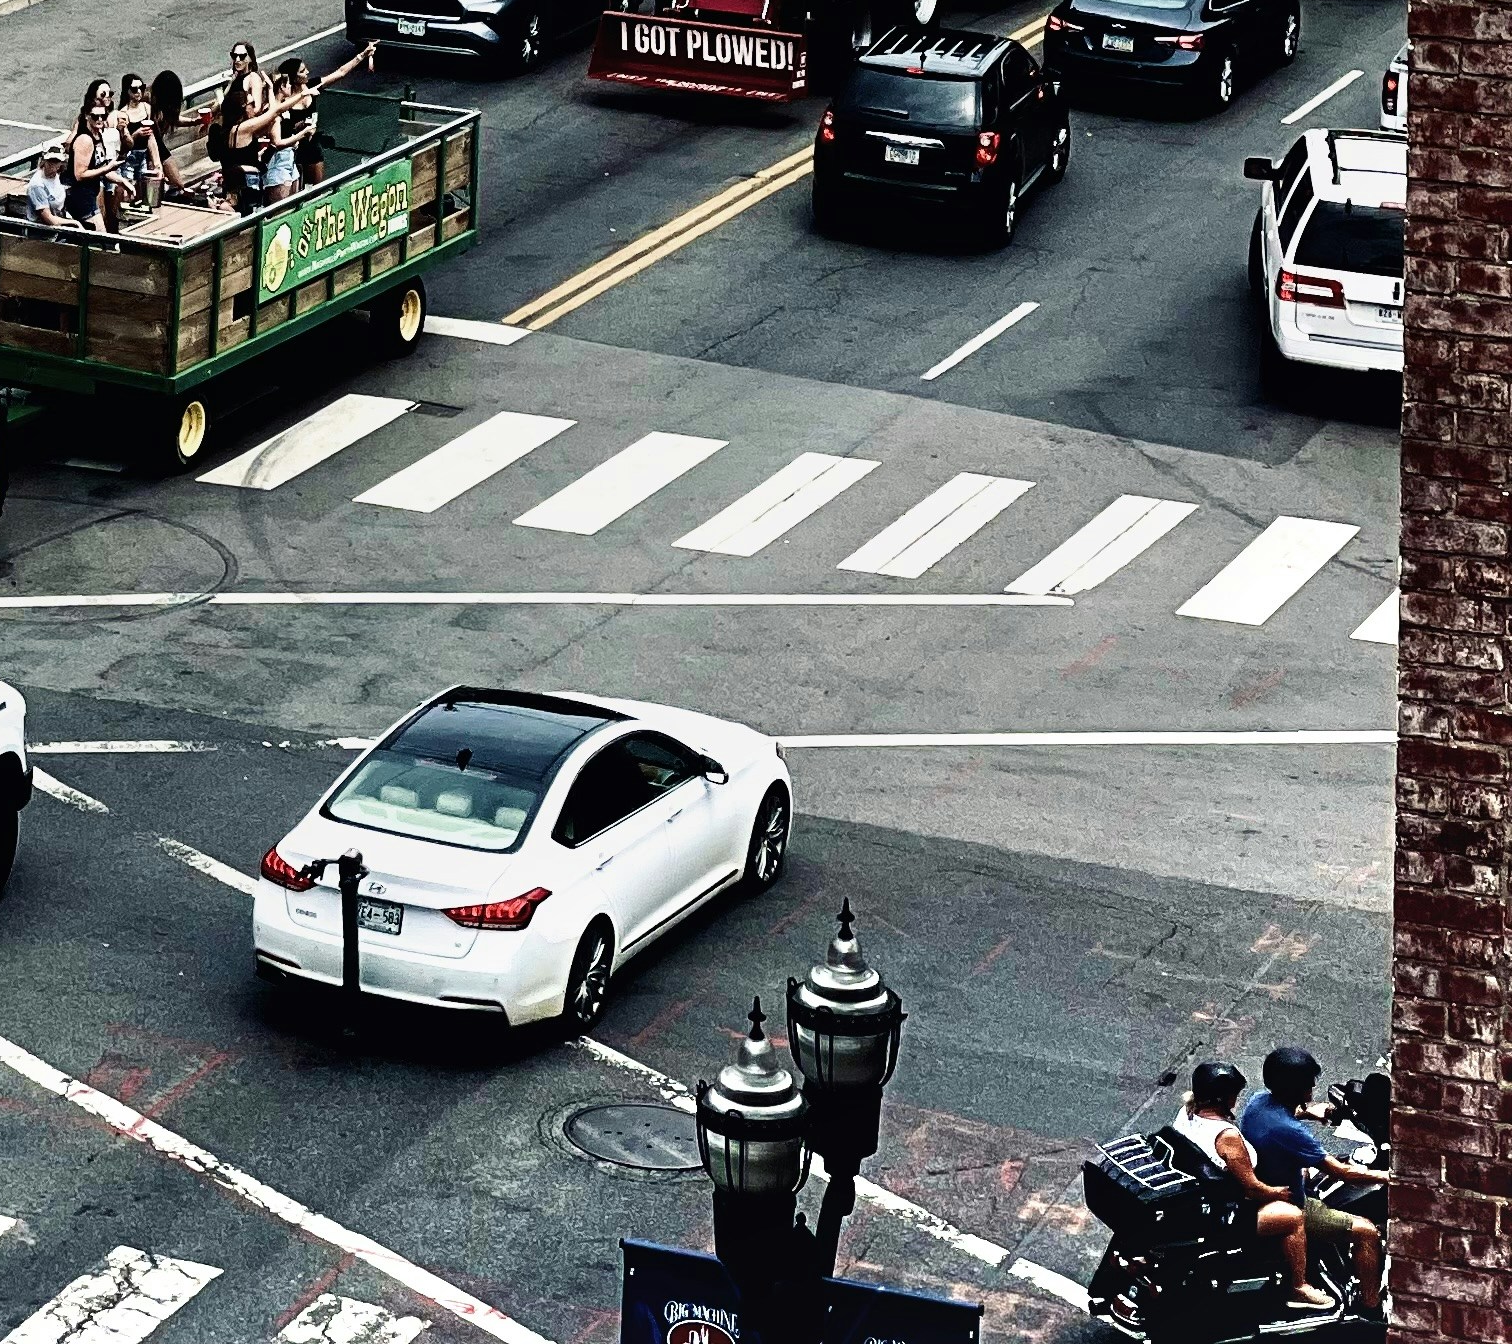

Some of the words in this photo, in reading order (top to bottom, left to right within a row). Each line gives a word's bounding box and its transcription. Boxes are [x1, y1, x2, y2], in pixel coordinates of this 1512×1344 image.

[621, 21, 628, 51] I
[635, 23, 681, 57] GOT
[687, 29, 794, 71] PLOWED!
[315, 201, 346, 252] The
[350, 180, 408, 239] Wagon
[664, 1300, 689, 1324] BIG
